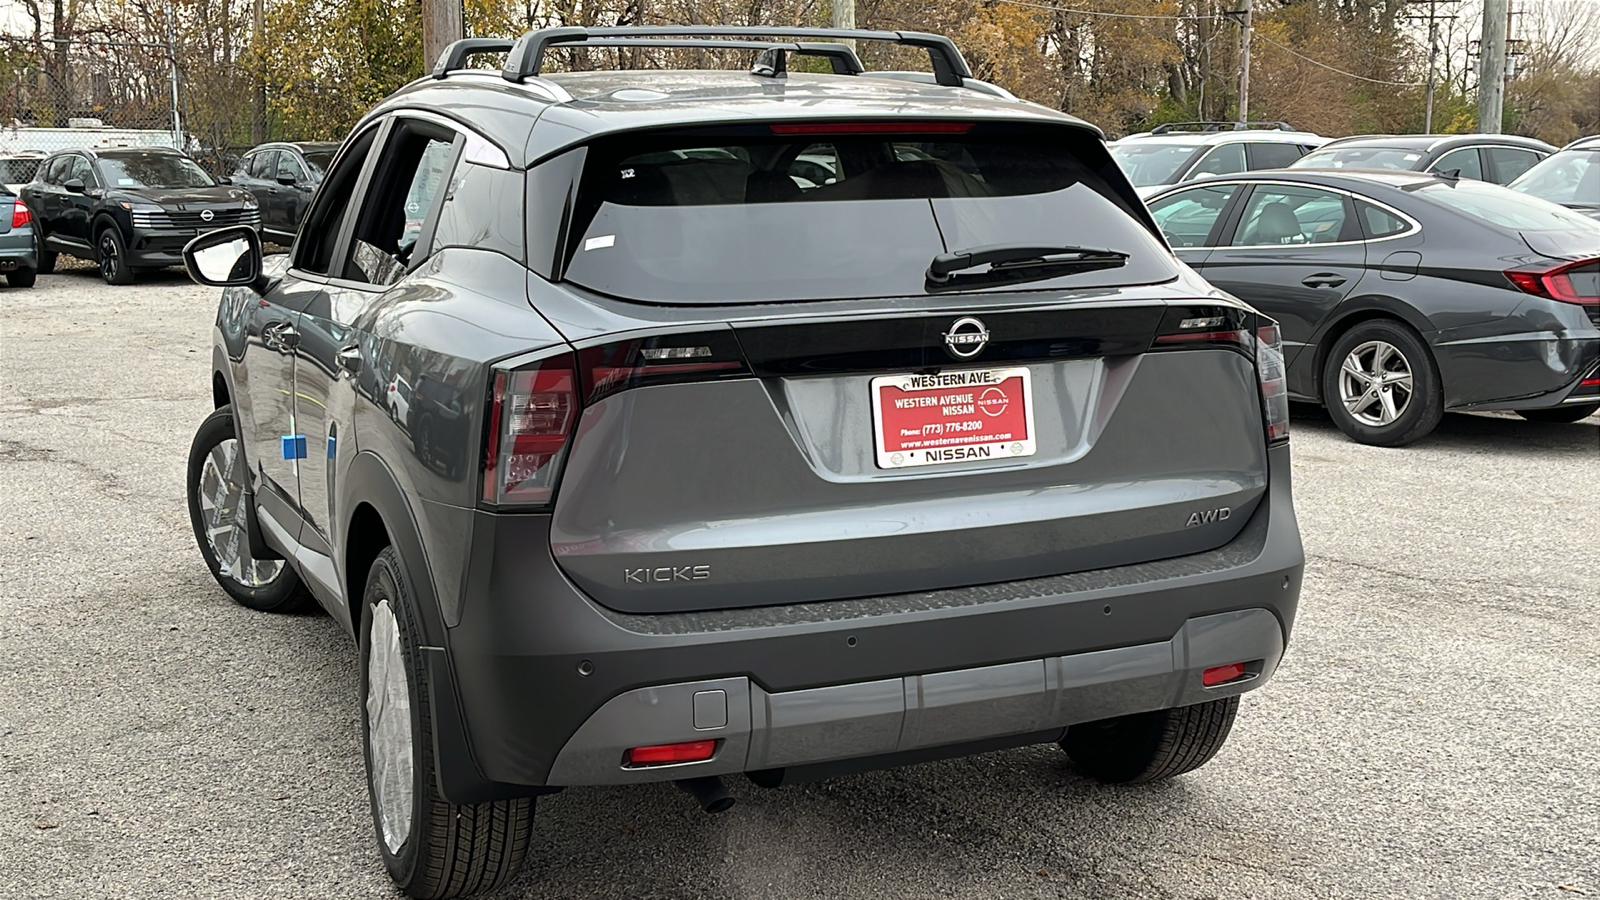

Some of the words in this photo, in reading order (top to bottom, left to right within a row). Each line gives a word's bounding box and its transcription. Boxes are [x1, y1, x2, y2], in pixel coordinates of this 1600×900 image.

[945, 334, 989, 344] NISSAN
[910, 373, 966, 388] WESTERN
[894, 397, 938, 409] WESTERN
[939, 393, 974, 405] AVENUE
[977, 398, 1009, 406] NISSAN
[942, 405, 975, 416] NISSAN
[900, 428, 922, 437] Phone:
[922, 424, 944, 437] (773)
[945, 420, 983, 433] 776-8200
[900, 433, 1012, 448] www.westernavenissan.com
[925, 446, 991, 462] NISSAN
[1186, 507, 1231, 527] AWD
[624, 565, 710, 583] KICKS
